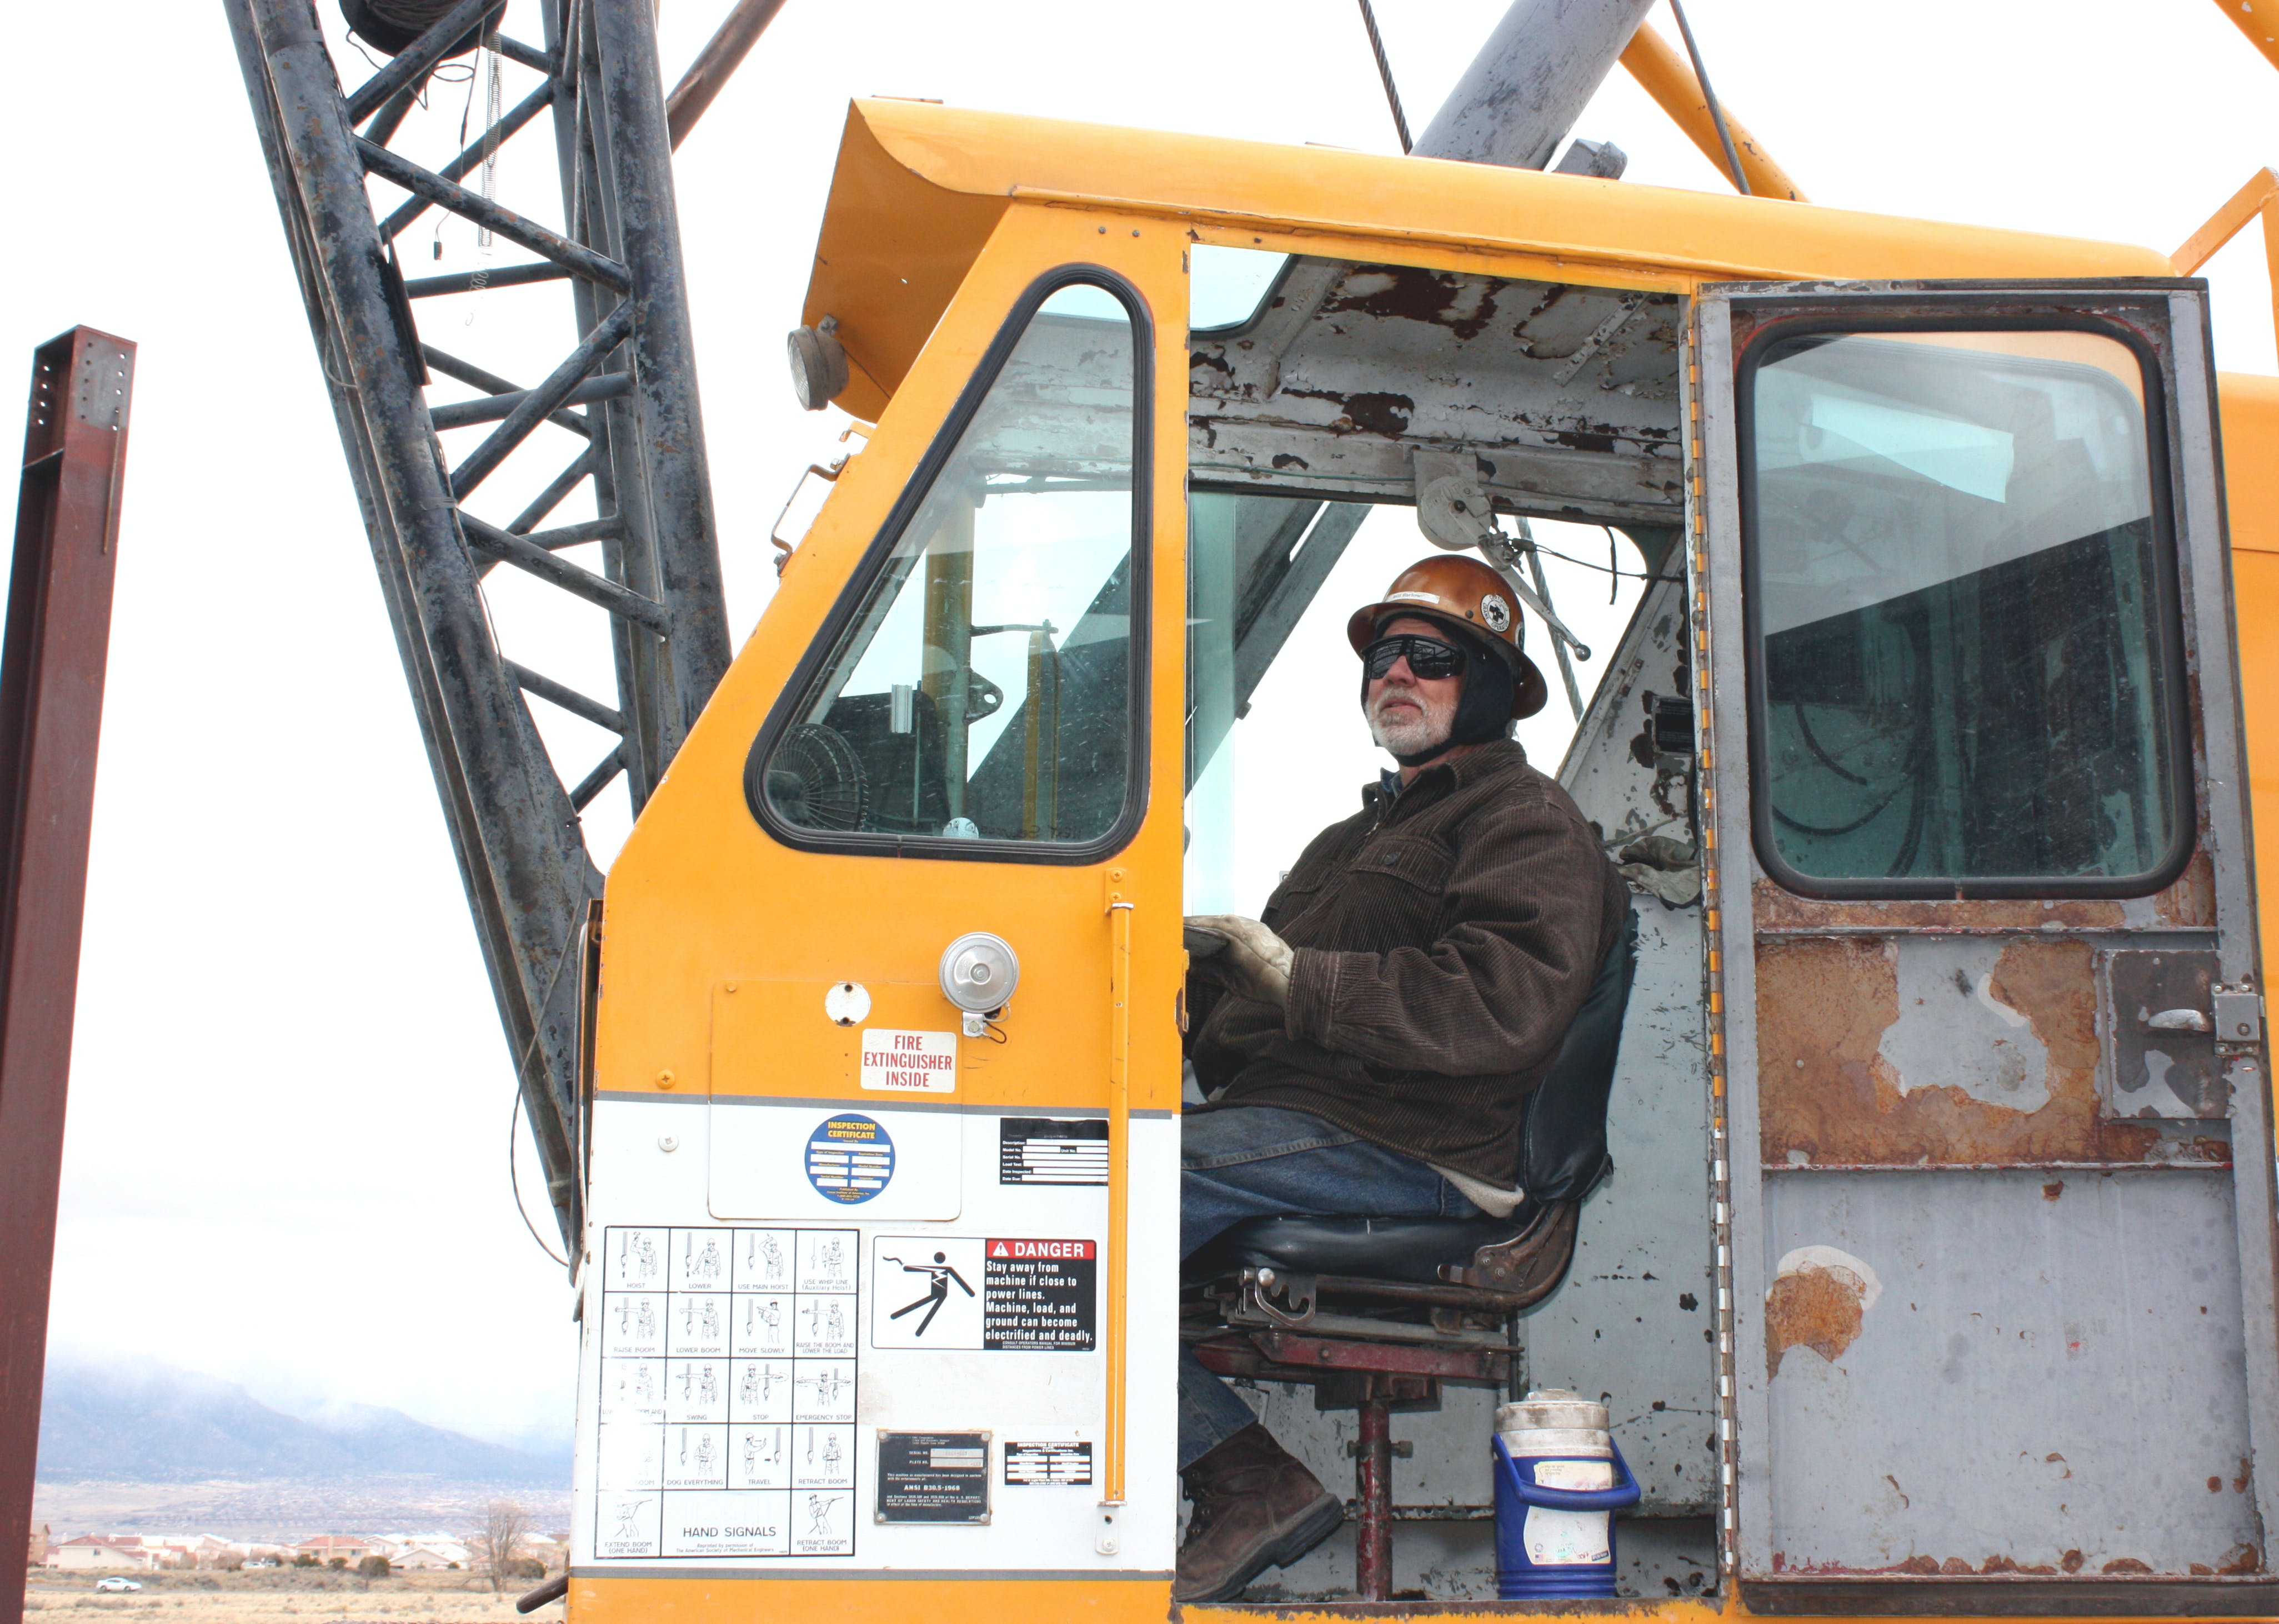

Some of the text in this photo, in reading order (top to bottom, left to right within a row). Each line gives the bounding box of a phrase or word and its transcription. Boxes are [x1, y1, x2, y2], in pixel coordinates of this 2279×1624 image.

[895, 1035, 923, 1051] FIRE
[864, 1052, 952, 1070] EXTINGUISHER
[886, 1071, 930, 1087] INSIDE
[828, 1121, 876, 1130] INSPECTION
[828, 1130, 875, 1139] CERTIFICATE
[1015, 1242, 1084, 1257] DANGER
[986, 1260, 1059, 1275] Stay away from
[986, 1275, 1076, 1286] machine if close to
[986, 1288, 1045, 1301] power lines.
[986, 1301, 1076, 1314] Machine, load, and
[985, 1316, 1078, 1329] ground can become
[985, 1329, 1093, 1343] electrified and deadly.
[683, 1527, 776, 1538] HAND SIGNALS
